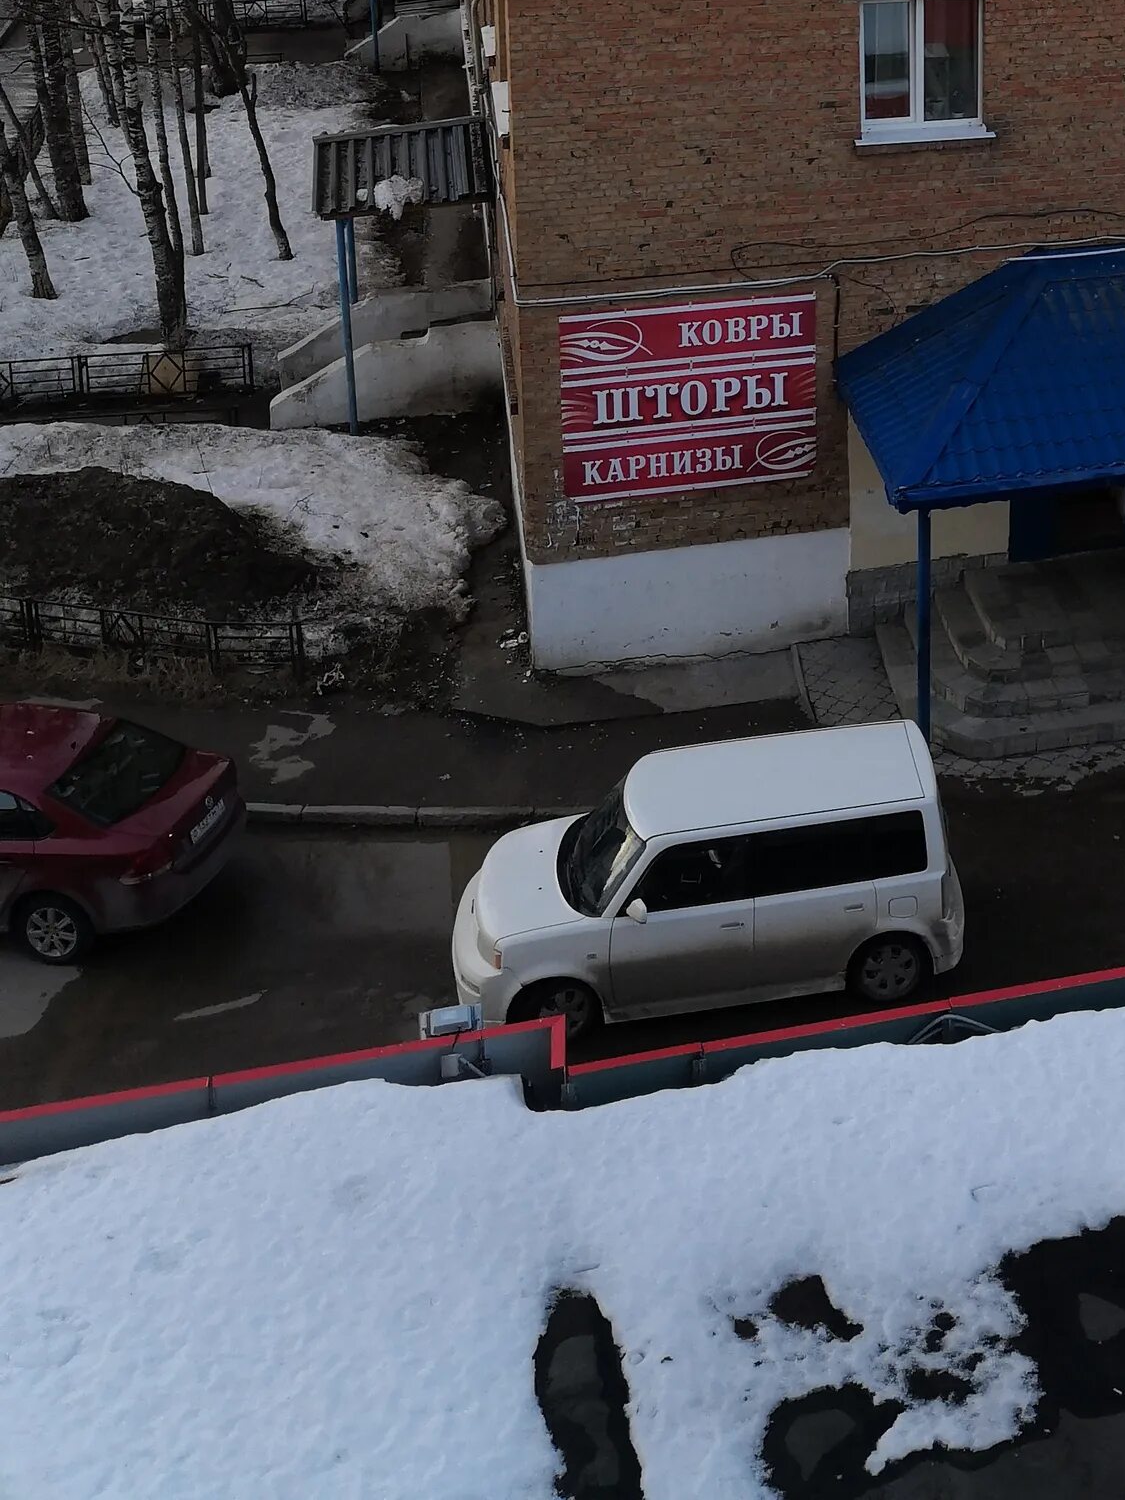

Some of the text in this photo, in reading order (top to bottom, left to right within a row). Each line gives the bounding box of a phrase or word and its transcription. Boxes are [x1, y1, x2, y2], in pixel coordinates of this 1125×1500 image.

[677, 311, 803, 348] КОВРЫ
[592, 372, 789, 425] ШТОРЫ
[582, 444, 743, 486] КАРНИЗЫ
